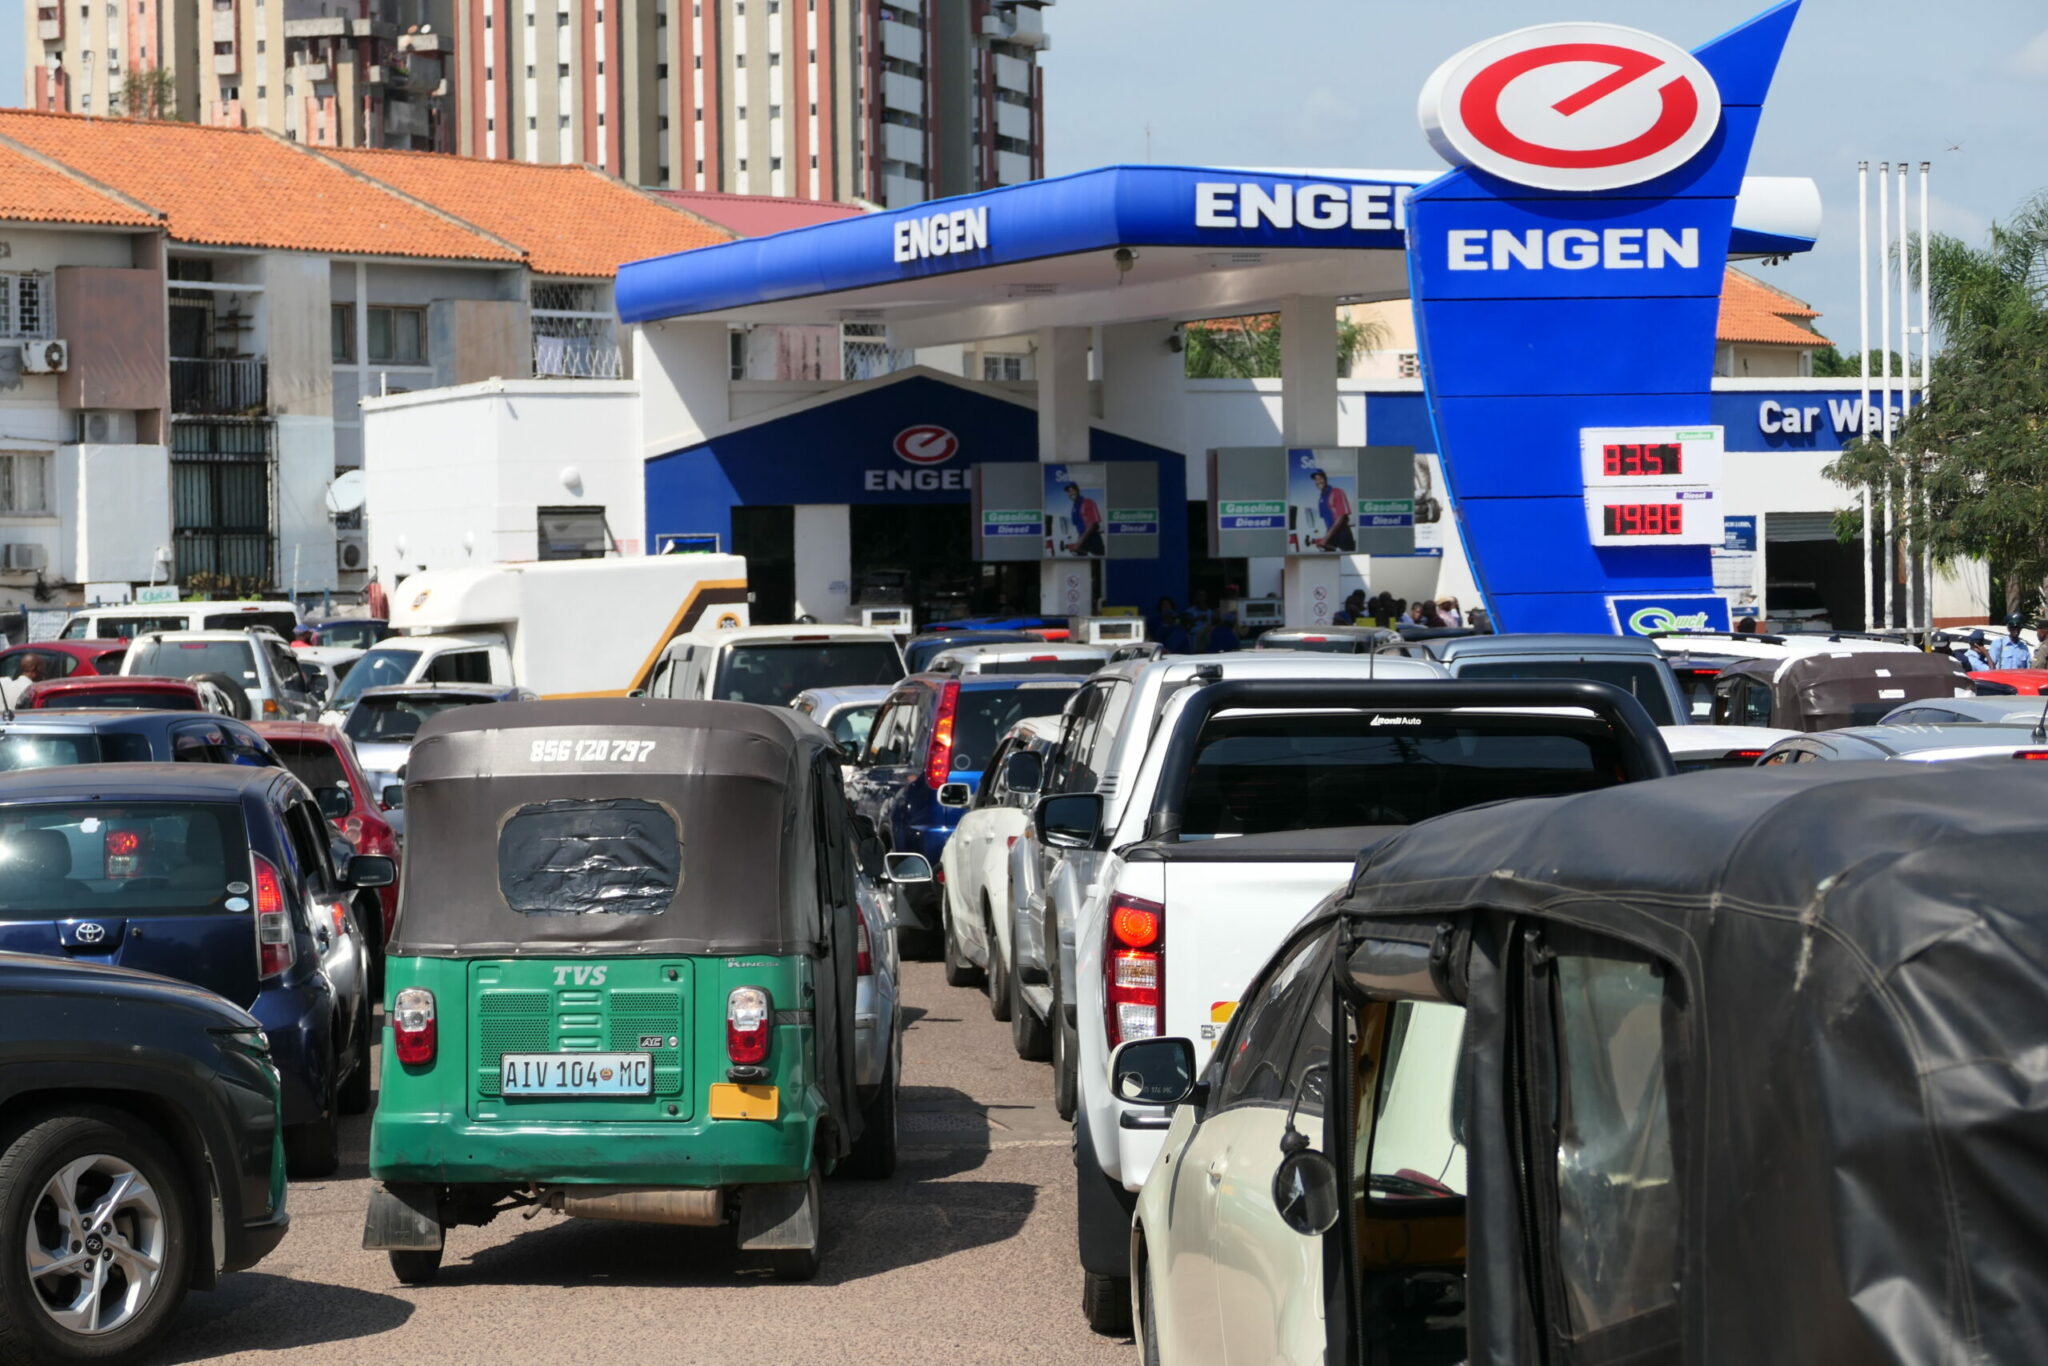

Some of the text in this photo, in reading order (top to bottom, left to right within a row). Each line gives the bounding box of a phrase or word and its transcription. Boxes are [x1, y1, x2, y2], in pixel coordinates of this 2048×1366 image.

[1195, 182, 1406, 230] ENGE
[893, 205, 988, 263] ENGEN
[1447, 227, 1699, 270] ENGEN
[1759, 399, 1820, 433] Car
[864, 469, 972, 491] ENGE
[1225, 502, 1281, 514] Gasolina
[1364, 502, 1409, 512] Gasolina
[988, 511, 1038, 522] Gasolina
[1111, 510, 1154, 521] Gasolina
[1235, 517, 1271, 528] Diesel
[1372, 516, 1402, 525] Diesel
[997, 524, 1029, 534] Diesel
[1119, 523, 1147, 533] Diesel
[529, 740, 656, 762] 856 120 797
[552, 965, 608, 986] TVS
[505, 1061, 646, 1087] AIV 104 MC
